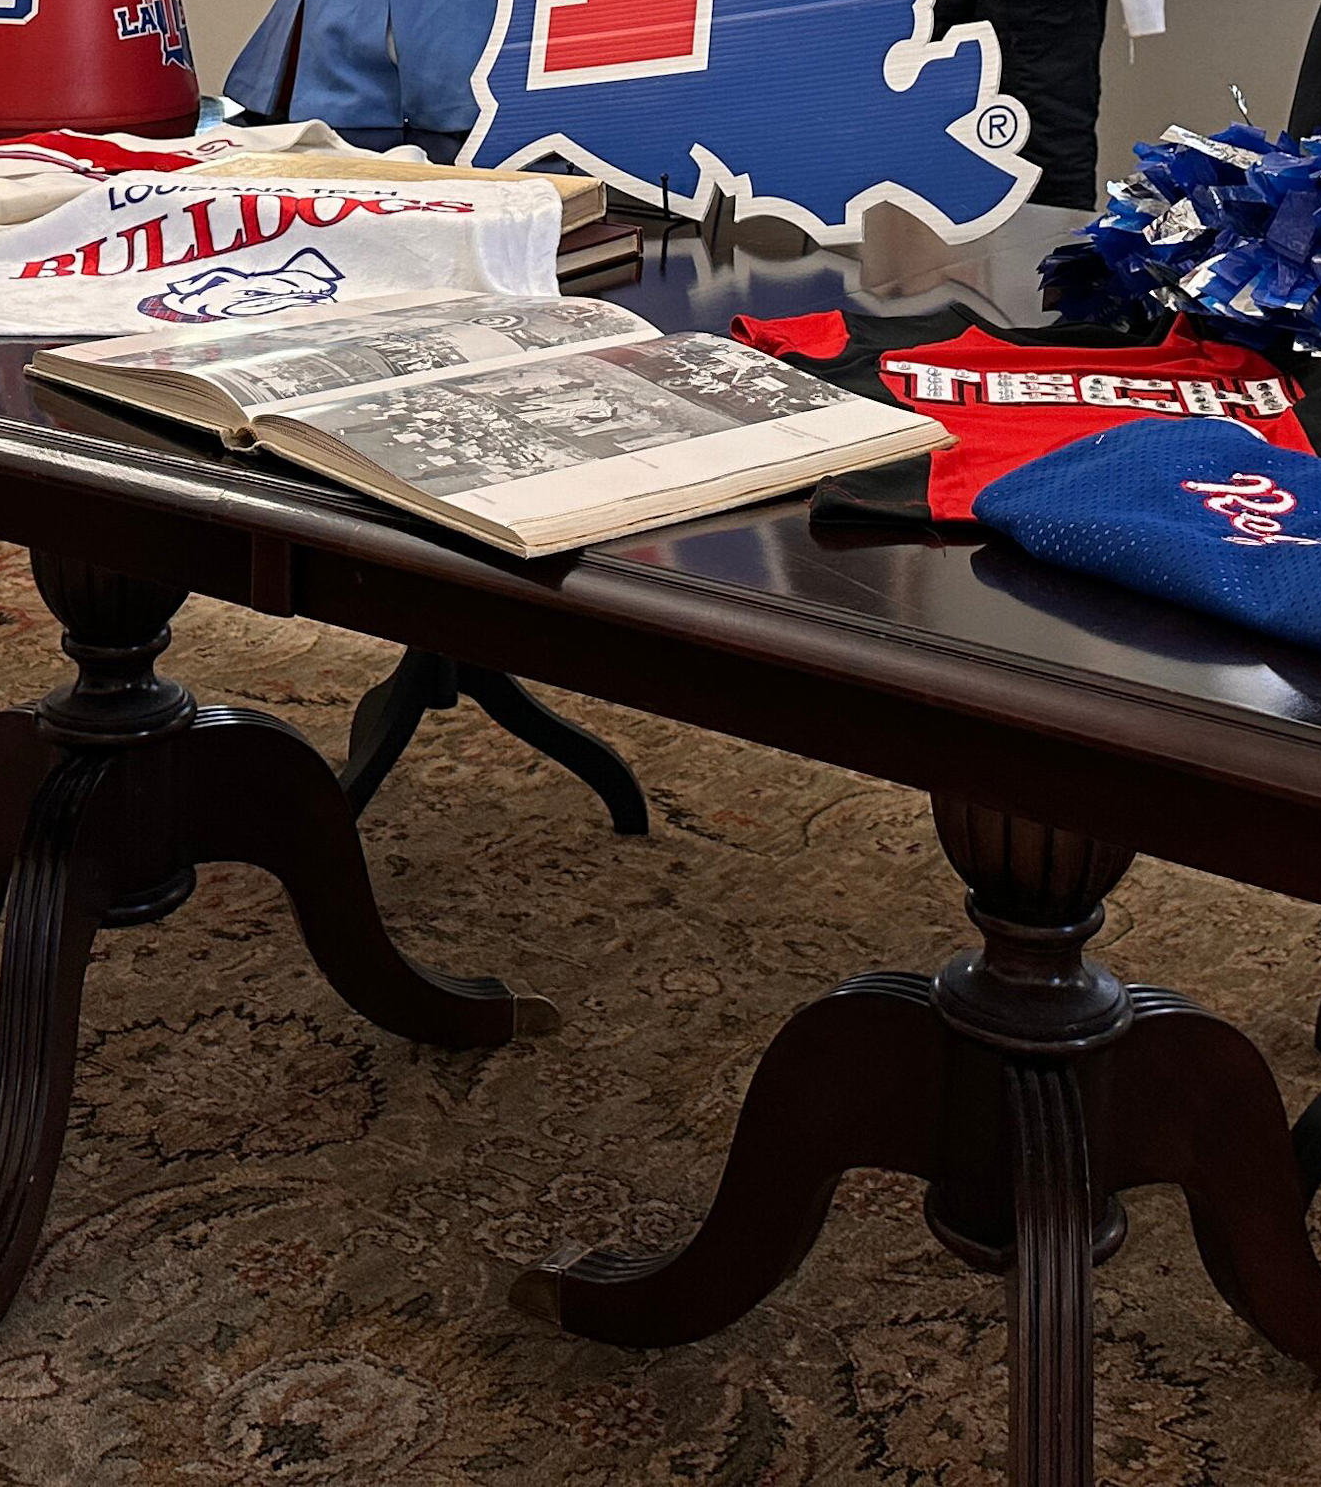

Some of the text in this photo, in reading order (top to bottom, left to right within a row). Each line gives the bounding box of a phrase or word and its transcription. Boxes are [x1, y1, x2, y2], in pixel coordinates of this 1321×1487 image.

[109, 184, 398, 211] LOUISIANA TECH
[9, 193, 475, 280] BULLDOGS
[885, 359, 1292, 418] TECH
